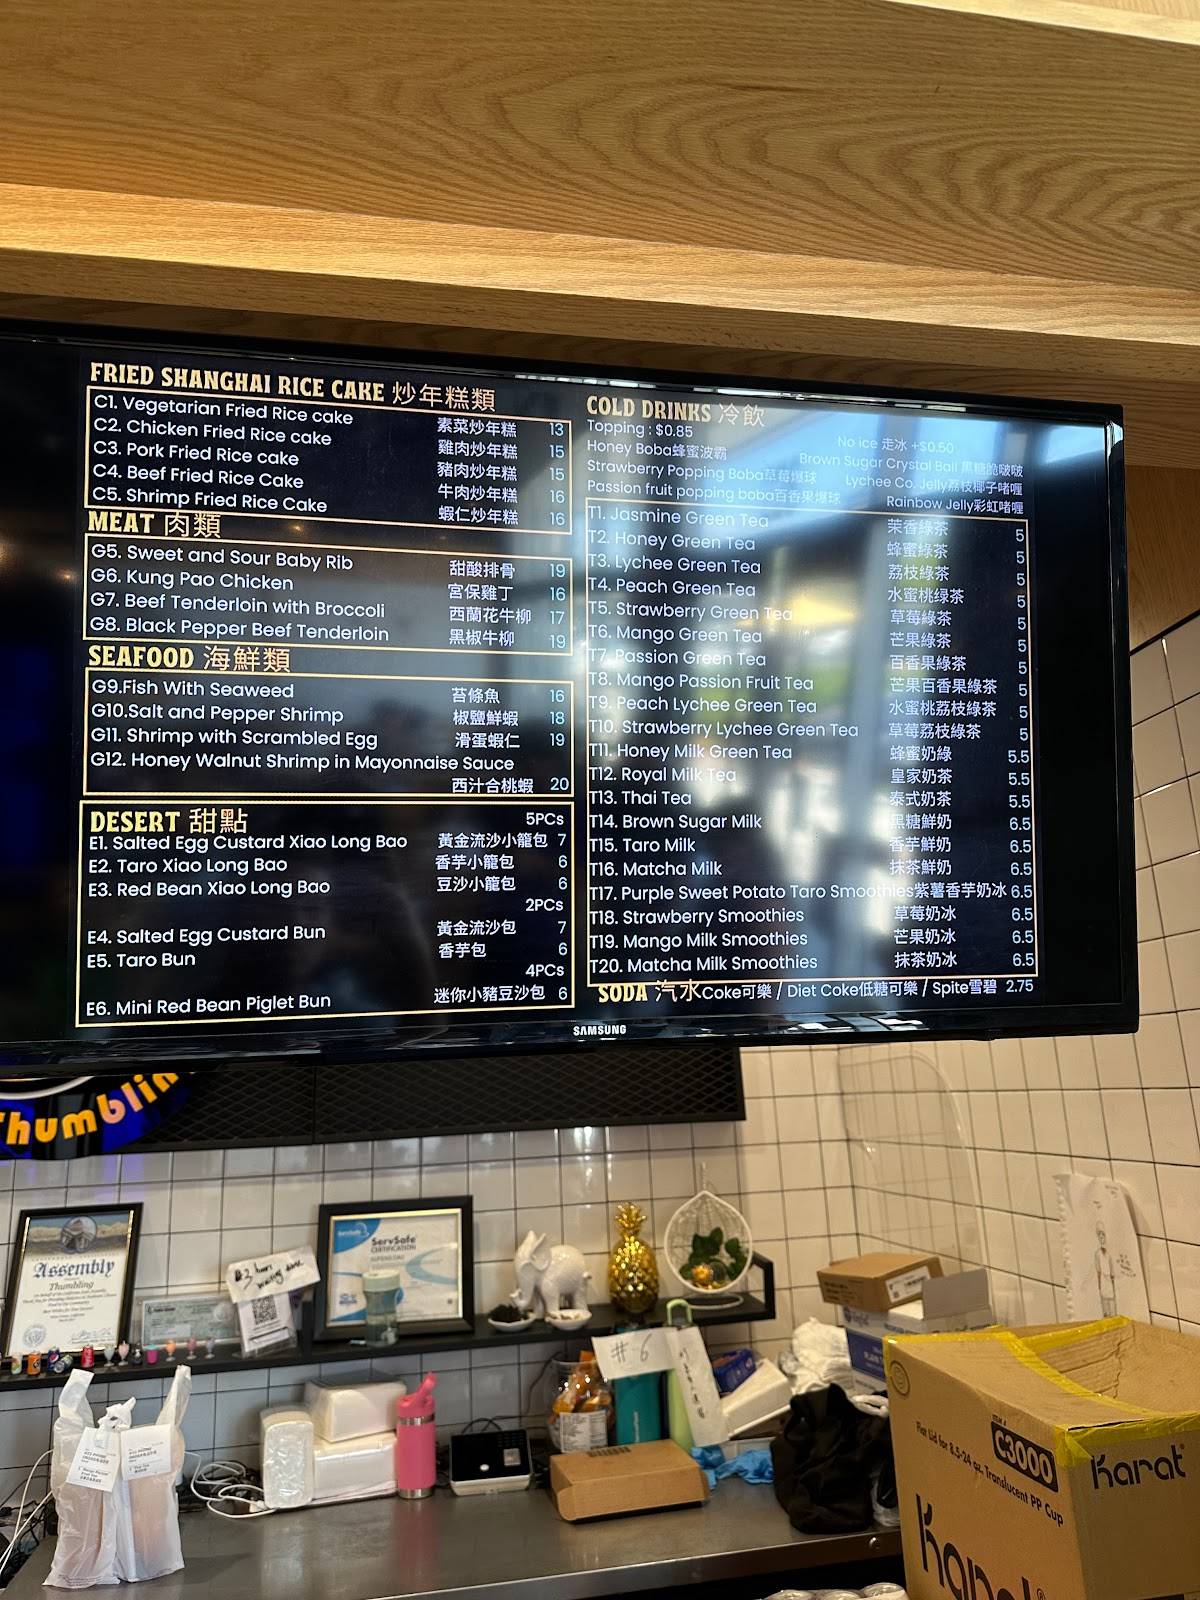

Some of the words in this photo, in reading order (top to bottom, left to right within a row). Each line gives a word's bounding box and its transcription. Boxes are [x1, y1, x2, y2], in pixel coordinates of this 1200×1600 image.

[90, 362, 154, 385] FRIED
[161, 368, 270, 393] SHANGHAI
[278, 375, 324, 398] RICE
[331, 380, 384, 401] CAKE
[392, 381, 495, 412] 炒年糕類
[94, 395, 117, 410] C1.
[123, 397, 220, 416] Vegetarian
[225, 403, 267, 419] Fried
[273, 405, 307, 422] Rice
[313, 409, 353, 425] cake
[437, 417, 517, 438] 素菜炒年糕
[549, 423, 564, 436] 13
[587, 395, 635, 418] COLD
[642, 400, 712, 422] DRINKS
[717, 403, 766, 428] 冷飲
[94, 418, 122, 433] C2.
[127, 419, 198, 438] Chicken
[203, 424, 245, 440] Fried
[250, 427, 285, 443] Rice
[290, 430, 331, 446] cake
[438, 440, 517, 460] 雞肉炒年糕
[550, 445, 564, 458] 15
[588, 420, 645, 438] Topping
[656, 423, 693, 438] $0.85
[588, 440, 631, 458] Honey
[887, 496, 941, 509] Rainbow
[88, 511, 154, 532] MEAT
[164, 511, 221, 538] 肉類
[588, 530, 609, 544] T2.
[615, 531, 667, 549] Honey
[672, 534, 721, 549] Green
[726, 536, 755, 551] Tea
[888, 541, 948, 558] 蜂蜜綠茶
[1016, 551, 1025, 564] 5
[92, 544, 122, 559] G5.
[127, 545, 183, 562] Sweet
[188, 548, 224, 564] and
[230, 550, 271, 566] Sour
[276, 552, 320, 572] Baby
[326, 554, 353, 570] Rib
[448, 560, 515, 579] 甜酸排骨
[550, 564, 565, 578] 19
[90, 592, 121, 608] G7.
[125, 593, 166, 609] Beef
[171, 595, 268, 613] Tenderloin
[273, 598, 310, 615] with
[315, 601, 385, 618] Broccoli
[448, 606, 531, 625] 西蘭花牛柳
[550, 611, 564, 625] 17
[589, 601, 611, 616] T5.
[616, 602, 705, 622] Strawberry
[711, 605, 759, 620] Green
[764, 606, 793, 620] Tea
[891, 610, 951, 626] 草莓綠茶
[1017, 617, 1026, 630] 5
[88, 646, 194, 669] SEAFOOD
[203, 646, 290, 673] 海鮮類
[92, 679, 158, 696] G9.Fish
[163, 681, 204, 697] With
[210, 683, 294, 699] Seaweed
[452, 687, 500, 705] 苔條魚
[550, 690, 564, 703] 16
[589, 672, 611, 687] T8.
[617, 673, 674, 692] Mango
[679, 674, 741, 689] Passion
[746, 676, 780, 690] Fruit
[785, 677, 813, 690] Tea
[890, 678, 997, 694] 芒果百香果綠茶
[1019, 684, 1027, 697] 5
[91, 729, 122, 744] G11.
[127, 728, 193, 748] Shrimp
[199, 729, 236, 745] with
[242, 730, 340, 747] Scrambled
[346, 732, 378, 750] Egg
[455, 732, 520, 750] 滑蛋蝦仁
[550, 733, 565, 746] 19
[590, 744, 611, 758] T11.
[617, 743, 669, 762] Honey
[674, 744, 705, 759] Milk
[710, 745, 758, 760] Green
[763, 746, 792, 759] Tea
[890, 746, 952, 762] 蜂蜜奶綠
[1008, 750, 1029, 764] 5.5
[590, 791, 617, 805] T13.
[622, 790, 657, 805] Thai
[663, 791, 692, 805] Tea
[890, 791, 951, 807] 泰式奶茶
[1009, 795, 1030, 808] 5.5
[90, 810, 180, 833] DESERT
[189, 808, 247, 834] 甜點
[526, 812, 564, 826] 5PCs
[90, 836, 107, 851] E1.
[113, 834, 169, 850] Salted
[175, 835, 208, 854] Egg
[213, 834, 284, 850] Custard
[290, 834, 327, 849] Xiao
[331, 833, 370, 852] Long
[376, 833, 407, 848] Bao
[438, 832, 548, 850] 黃金流沙小籠包
[558, 834, 566, 847] 7
[525, 899, 563, 912] 2PCs
[87, 953, 111, 969] E5.
[117, 952, 156, 968] Taro
[162, 952, 195, 967] Bun
[439, 942, 486, 959] 香芋包
[558, 943, 567, 956] 6
[590, 959, 623, 974] T20.
[627, 957, 692, 972] Matcha
[697, 957, 727, 971] Milk
[732, 955, 817, 970] Smoothies
[894, 952, 957, 968] 抹茶奶冰
[1012, 953, 1034, 966] 6.5
[86, 1001, 111, 1016] E6.
[116, 999, 152, 1015] Mini
[158, 997, 191, 1014] Red
[197, 997, 241, 1013] Bean
[246, 994, 294, 1013] Piglet
[299, 993, 331, 1009] Bun
[434, 985, 545, 1004] 迷你小豬豆沙包
[558, 986, 567, 1000] 6
[599, 985, 648, 1002] SODA
[776, 981, 783, 1001] /
[788, 983, 816, 998] Diet
[922, 978, 928, 997] /
[1006, 979, 1034, 993] 2.75
[573, 1024, 626, 1036] SAMSUNG
[372, 1235, 416, 1246] ServSafe
[34, 1259, 115, 1278] Assembly
[49, 1281, 94, 1291] Thumbling
[611, 1341, 629, 1362] #
[640, 1333, 652, 1362] 6
[995, 1430, 1053, 1484] C3000
[1092, 1444, 1186, 1490] Karat
[929, 1427, 937, 1443] Lid
[939, 1434, 948, 1451] for
[950, 1442, 972, 1466] 8.5-24
[985, 1465, 1028, 1504] Translucent
[1031, 1494, 1041, 1511] PP
[1045, 1503, 1064, 1527] Cup
[916, 1493, 1031, 1600] Kar
